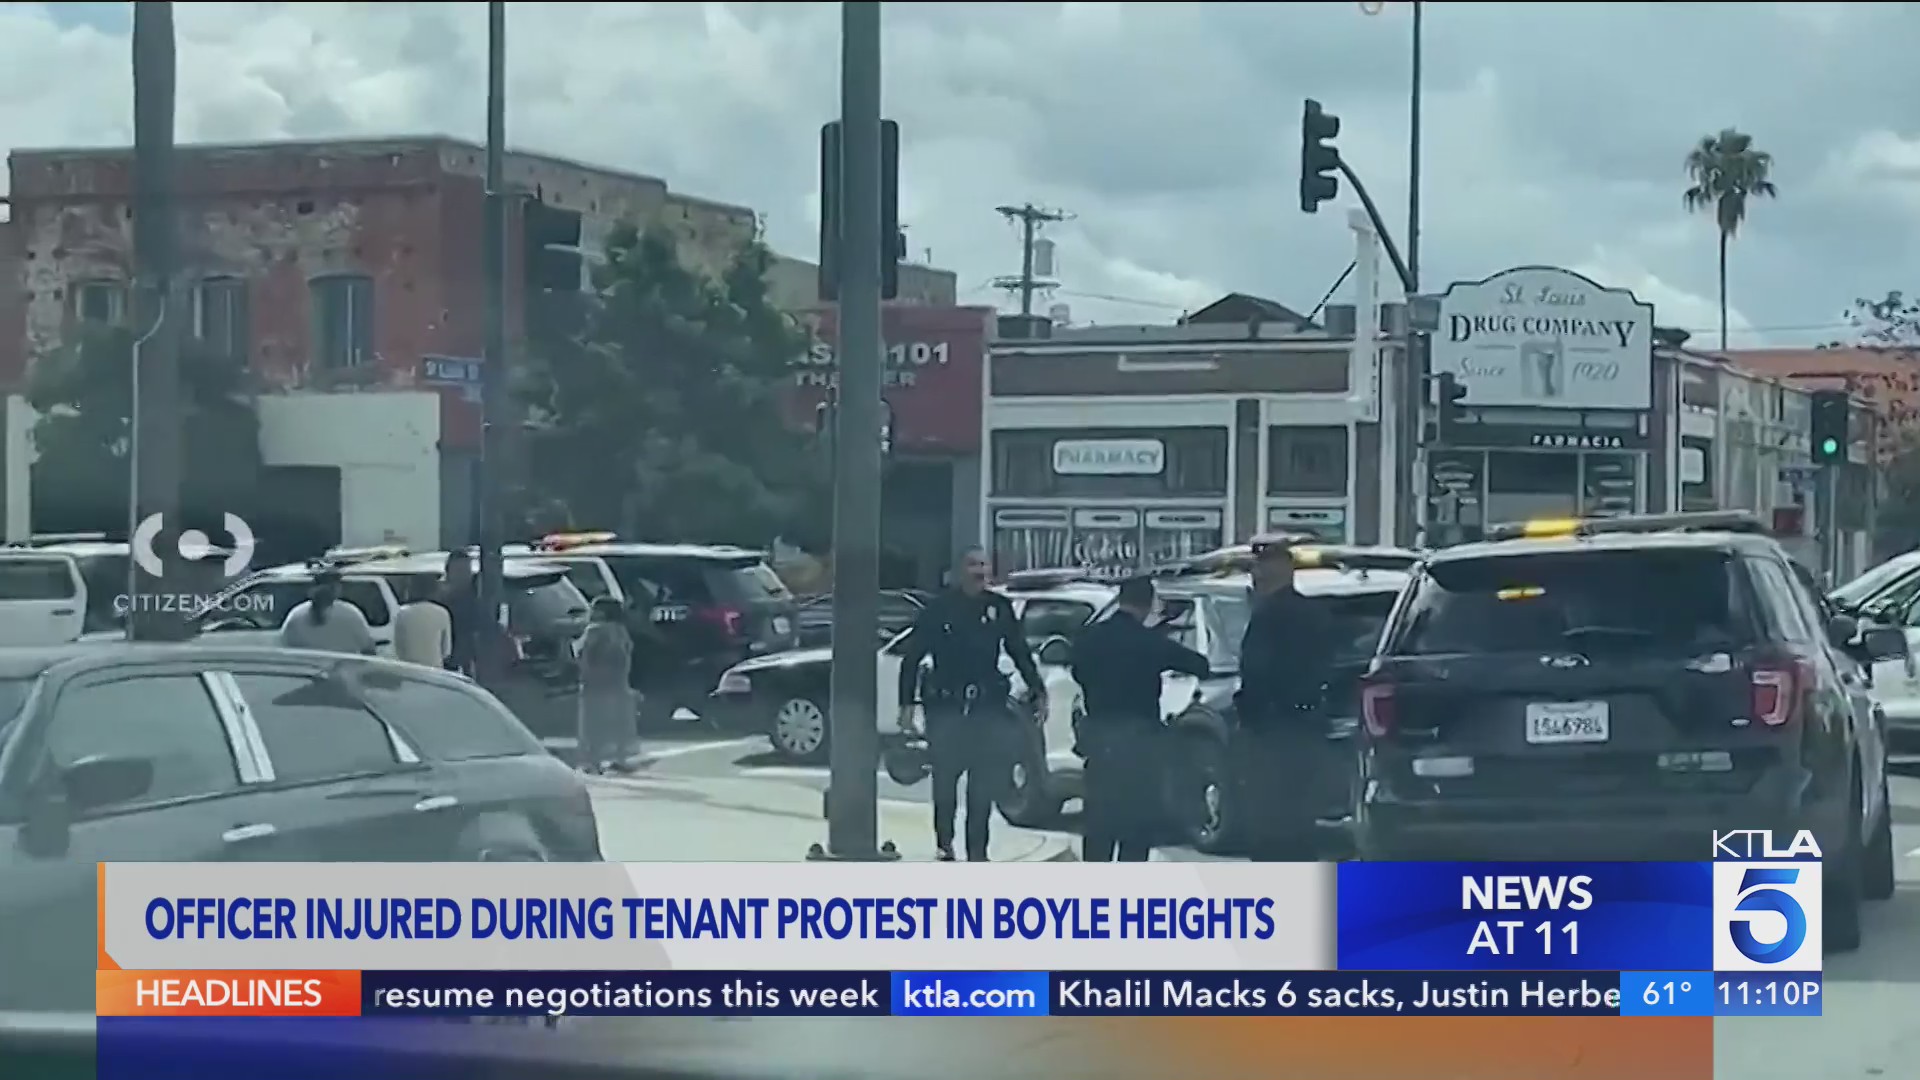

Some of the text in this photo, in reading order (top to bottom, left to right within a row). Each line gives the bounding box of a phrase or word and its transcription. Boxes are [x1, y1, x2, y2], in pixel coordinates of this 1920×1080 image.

[1450, 313, 1636, 347] DRUG COMPANY
[1571, 361, 1620, 382] 1920
[1531, 434, 1624, 448] FARMACIA
[1058, 448, 1160, 467] PHARMACY
